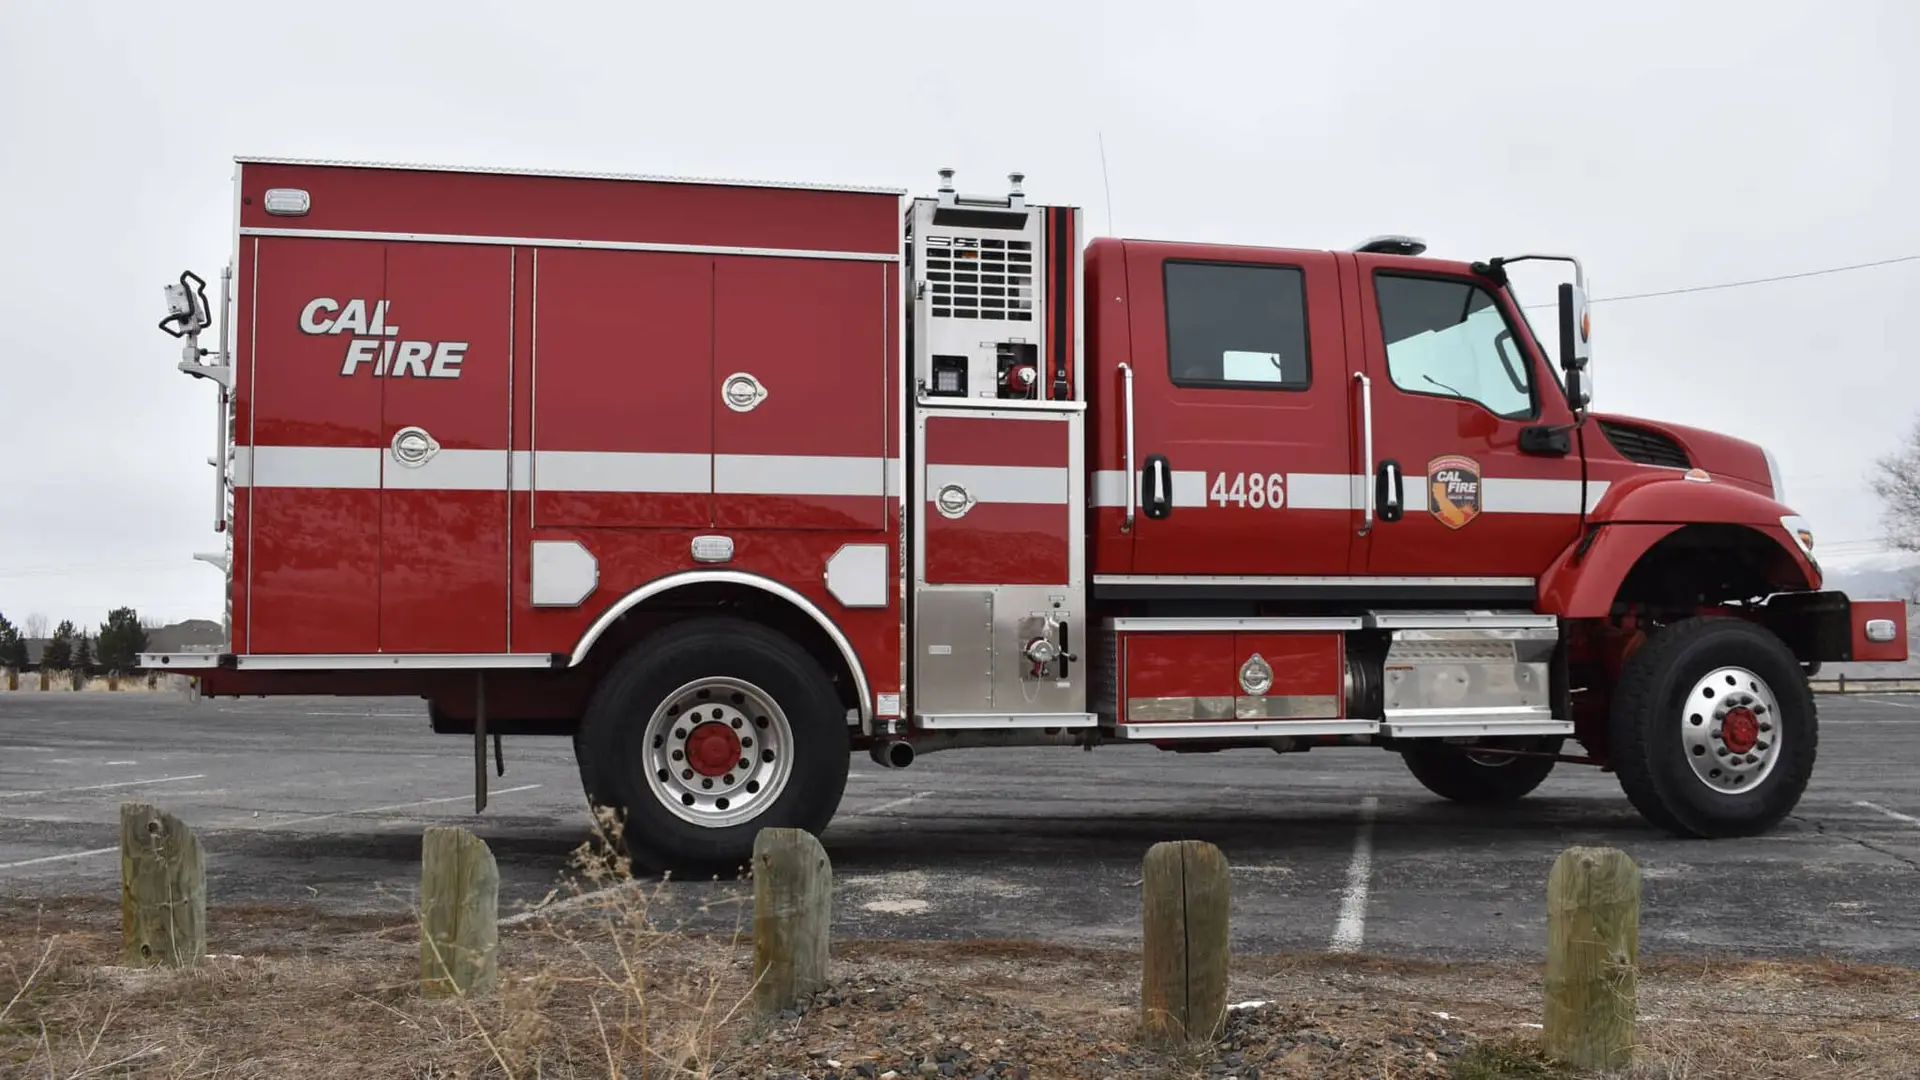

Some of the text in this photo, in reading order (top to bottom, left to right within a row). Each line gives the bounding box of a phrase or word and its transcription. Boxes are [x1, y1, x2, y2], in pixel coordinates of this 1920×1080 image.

[299, 297, 400, 336] CAL
[340, 339, 469, 378] FIRE
[1209, 471, 1284, 509] 4486
[1436, 471, 1462, 482] CAL
[1447, 482, 1478, 493] FIRE
